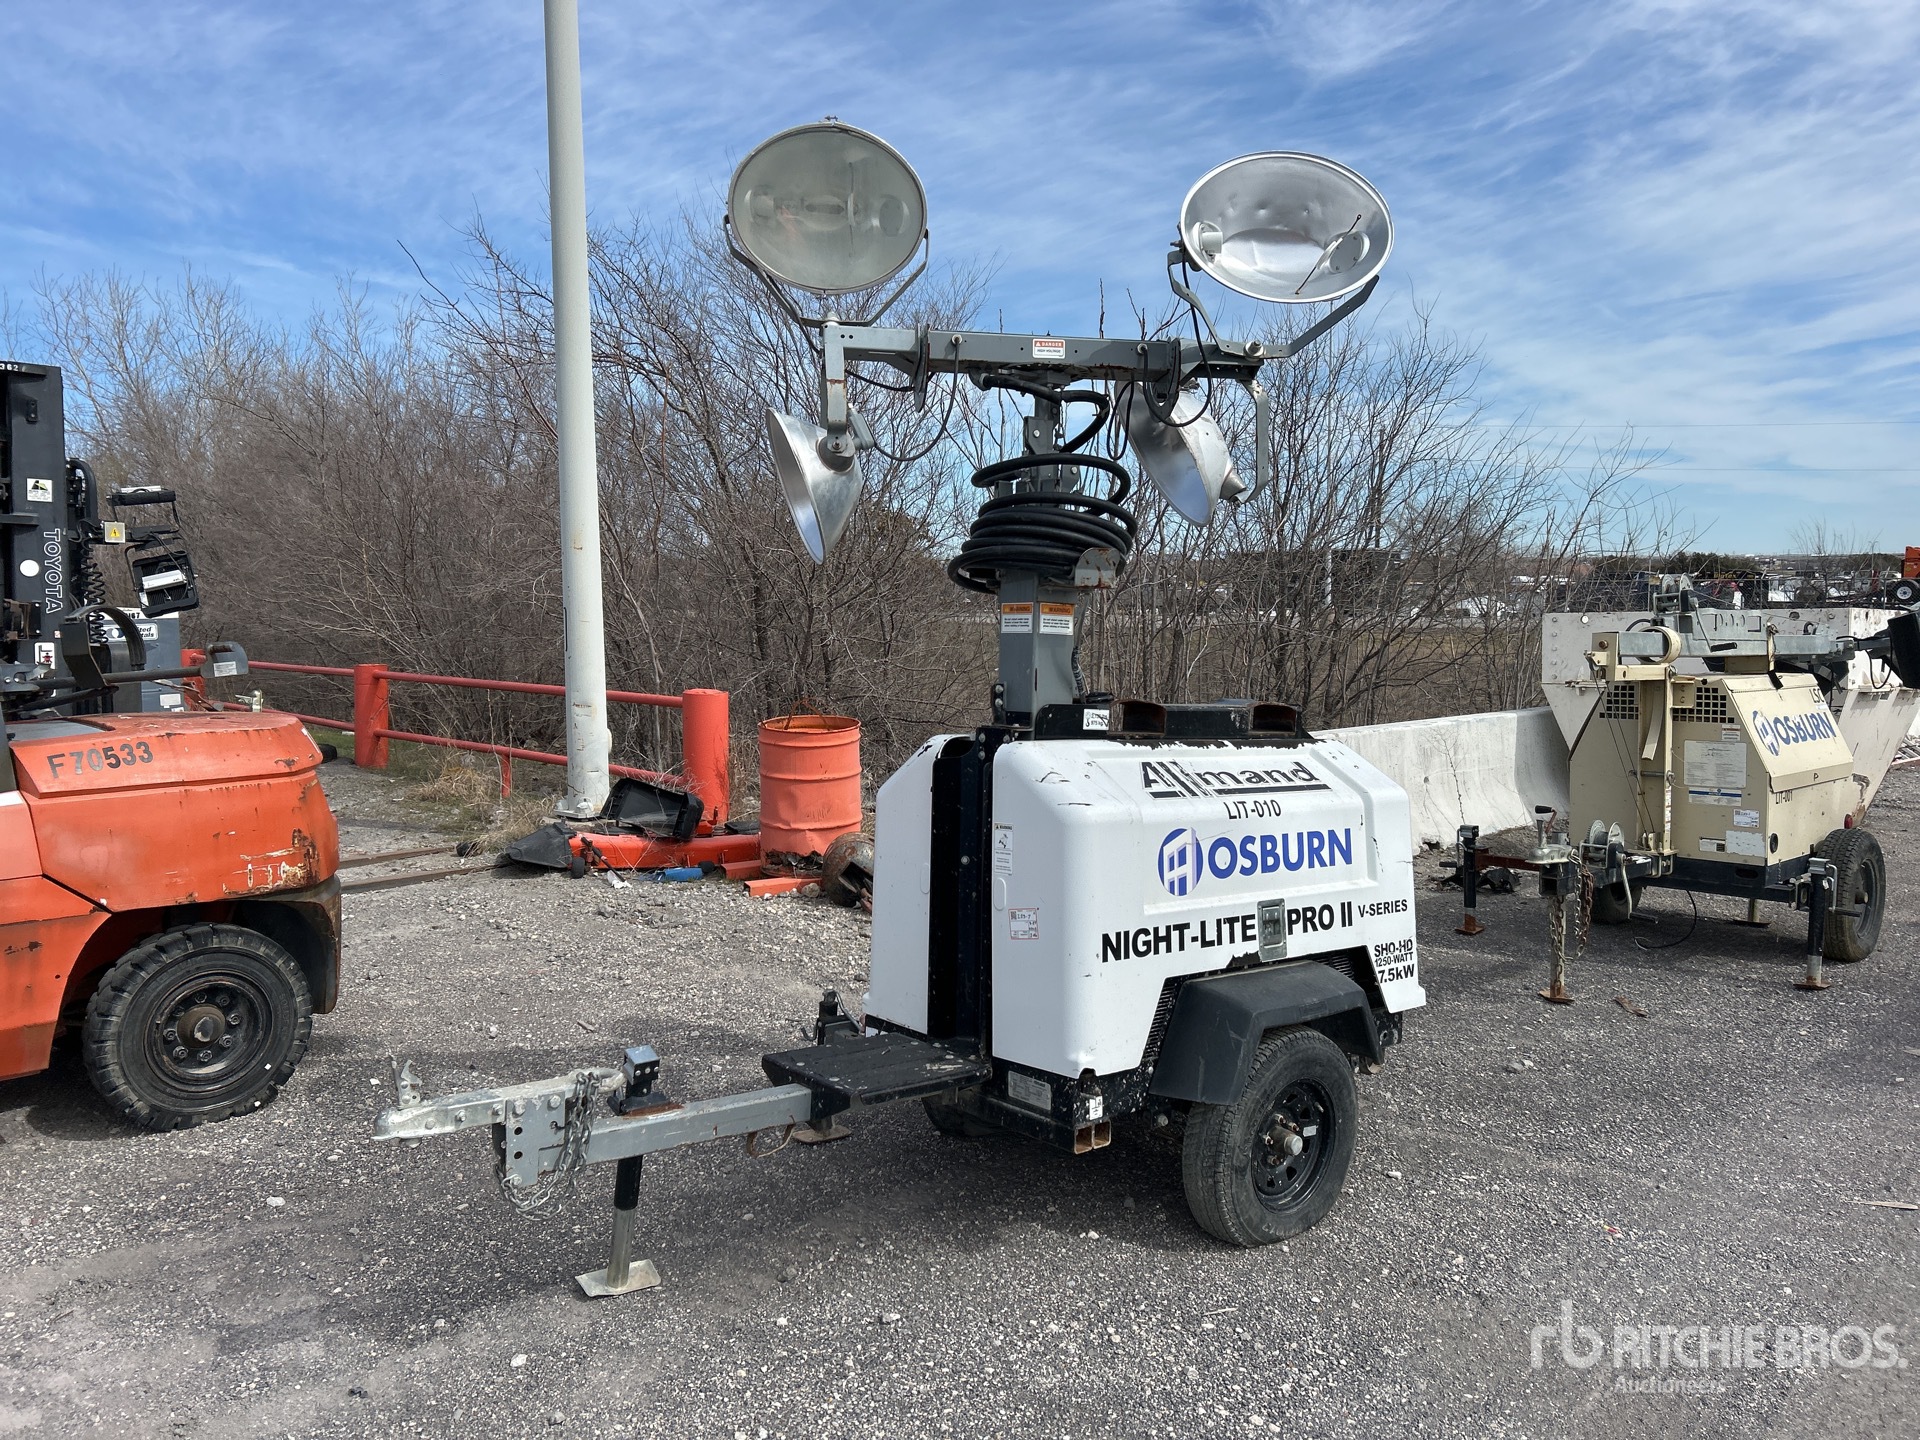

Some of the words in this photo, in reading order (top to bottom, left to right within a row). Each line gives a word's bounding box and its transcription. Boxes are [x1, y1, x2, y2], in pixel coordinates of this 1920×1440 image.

[43, 528, 63, 614] TOYOTA
[1773, 712, 1836, 745] OSBURN
[46, 741, 154, 779] F70533
[1140, 761, 1321, 798] Allmand
[1223, 799, 1282, 820] LIT-010
[1207, 827, 1353, 880] OSBURN
[1101, 913, 1257, 963] NIGHT-LITE
[1287, 903, 1335, 936] PRO
[1340, 900, 1353, 928] II
[1358, 898, 1408, 918] V-SERIES
[1374, 938, 1413, 958] SHO-HD
[1374, 951, 1413, 968] 1250-WATT
[1378, 963, 1415, 984] 7.5kW
